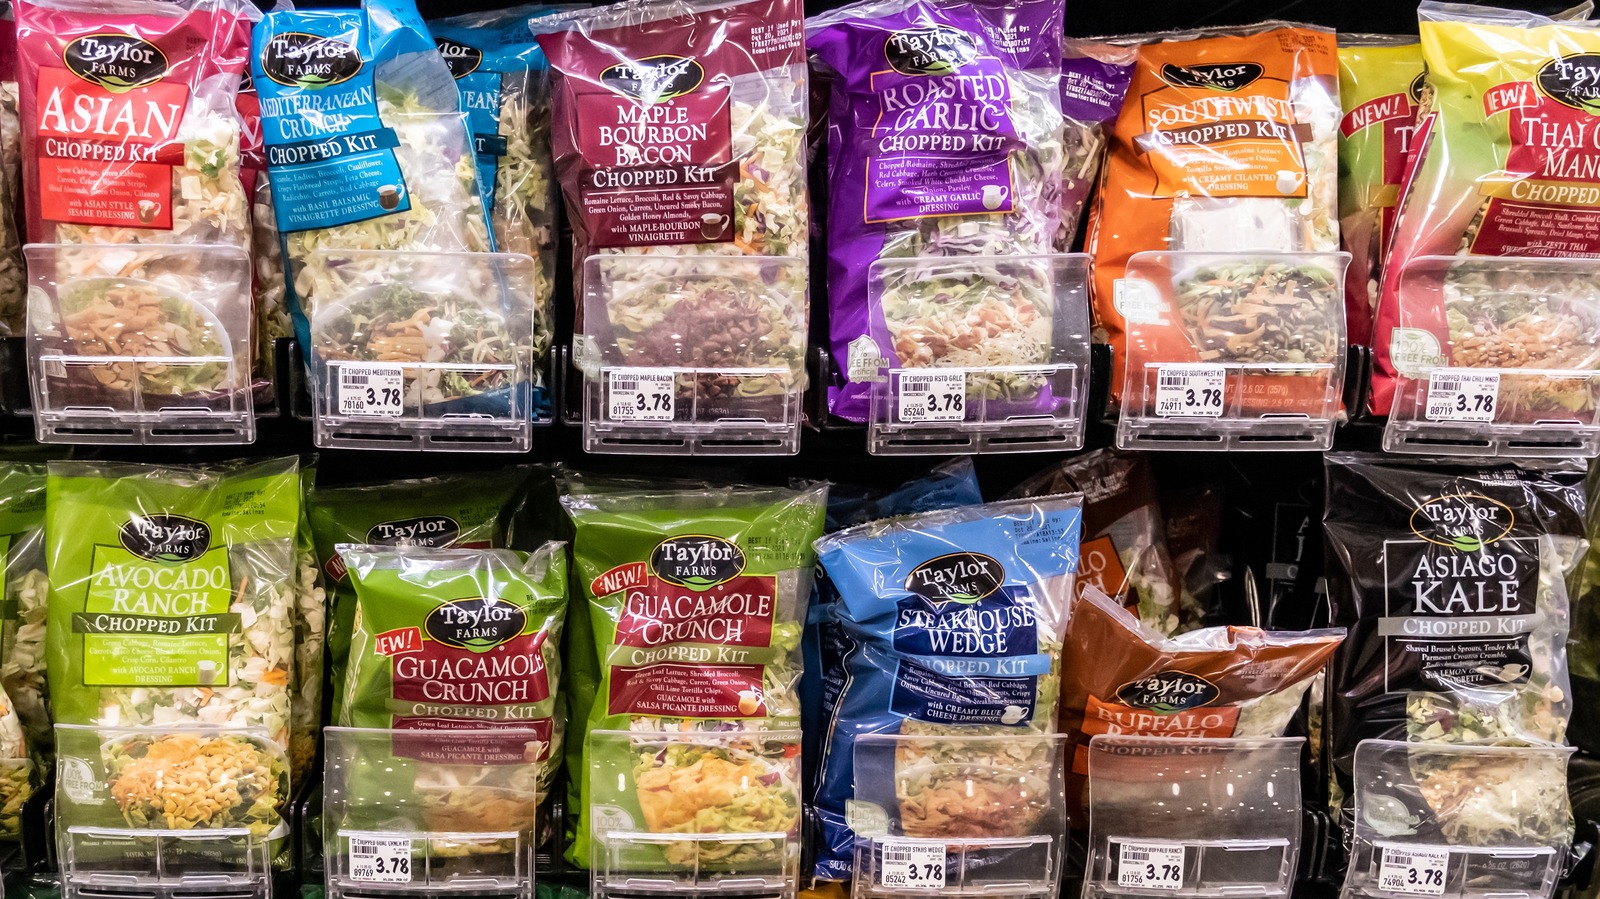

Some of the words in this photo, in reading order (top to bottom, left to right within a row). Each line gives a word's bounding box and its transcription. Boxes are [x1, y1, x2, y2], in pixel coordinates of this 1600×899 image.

[81, 38, 154, 64] Taylor
[890, 30, 962, 54] Taylor
[273, 40, 348, 64] Taylor
[92, 63, 136, 78] FARMS
[288, 64, 331, 75] FARMS
[883, 73, 1005, 112] ROASTED
[259, 86, 373, 118] MEDITERRANEAN
[1148, 95, 1291, 127] SOUTHWEST
[40, 86, 181, 139] ASIAN
[617, 105, 688, 124] MAPLE
[894, 104, 1000, 132] GARLIC
[1352, 96, 1399, 129] NEW!
[280, 112, 350, 139] CRUNCH
[599, 123, 707, 145] BOURBON
[1158, 122, 1250, 146] CHOPPED
[1255, 120, 1287, 138] KIT
[1520, 117, 1585, 148] THAI
[45, 139, 125, 161] CHOPPED
[129, 144, 161, 162] KIT
[270, 141, 342, 165] CHOPPED
[345, 135, 376, 154] KIT
[879, 134, 966, 154] CHOPPED
[972, 136, 1005, 151] KIT
[615, 145, 691, 166] BACON
[594, 167, 678, 187] CHOPPED
[685, 167, 716, 182] KIT
[1199, 174, 1232, 183] CREAMY
[1234, 173, 1276, 181] CILANTRO
[1208, 183, 1248, 191] DRESSING
[1511, 180, 1599, 204] CHOPPED
[84, 200, 107, 209] ASIAN
[109, 201, 133, 209] STYLE
[308, 200, 330, 211] BASIL
[332, 193, 370, 208] BALSAMIC
[589, 205, 606, 213] Green
[608, 205, 628, 213] Onion,
[630, 203, 652, 213] Carrots,
[654, 202, 679, 211] Uncured
[681, 202, 700, 210] Smoky
[702, 200, 722, 209] Bacon,
[896, 198, 912, 206] with
[914, 194, 948, 203] CREAMY
[950, 192, 980, 202] GARLIC
[919, 203, 959, 213] DRESSING
[68, 208, 94, 217] SESAME
[96, 209, 135, 220] DRESSING
[289, 208, 340, 223] VINAIGRETTE
[343, 202, 379, 217] DRESSING
[620, 213, 639, 221] Golden
[640, 212, 660, 222] Honey
[661, 211, 691, 220] Almonds,
[611, 225, 627, 233] with
[630, 221, 700, 231] MAPLE-BOURBON
[628, 232, 685, 241] VINAIGRETTE
[344, 401, 364, 409] 78160
[366, 388, 400, 406] 3.78
[637, 393, 671, 411] 3.78
[927, 394, 962, 412] 3.78
[1161, 402, 1182, 410] 74911
[1186, 389, 1222, 407] 3.78
[1456, 394, 1494, 412] 3.78
[613, 406, 634, 415] 81755
[904, 408, 925, 416] 85240
[1426, 503, 1499, 525] Taylor
[139, 520, 203, 541] Taylor
[378, 519, 446, 541] Taylor
[149, 542, 190, 554] FARMS
[662, 543, 732, 563] Taylor
[676, 566, 717, 576] FARMS
[916, 560, 989, 588] Taylor
[1413, 554, 1517, 579] ASIAGO
[95, 561, 227, 591] AVOCADO
[603, 567, 642, 593] NEW!
[111, 588, 209, 615] RANCH
[627, 591, 771, 619] GUACAMOLE
[1411, 581, 1521, 614] KALE
[95, 615, 181, 634] CHOPPED
[186, 617, 217, 632] KIT
[440, 605, 513, 629] Taylor
[899, 604, 1035, 631] STEAKHOUSE
[456, 627, 498, 639] FARMS
[642, 618, 742, 644] CRUNCH
[1403, 618, 1491, 635] CHOPPED
[1496, 618, 1527, 633] KIT
[929, 630, 1008, 654] WEDGE
[631, 647, 711, 666] CHOPPED
[717, 647, 749, 663] KIT
[129, 666, 167, 674] AVOCADO
[396, 654, 544, 680] GUACAMOLE
[996, 658, 1028, 674] KIT
[135, 675, 173, 683] DRESSING
[1135, 675, 1207, 696] Taylor
[423, 680, 528, 702] CRUNCH
[657, 694, 700, 703] GUACAMOLE
[1142, 694, 1187, 705] FARMS
[412, 703, 498, 719] CHOPPED
[503, 705, 537, 719] KIT
[637, 701, 660, 709] SALSA
[662, 702, 697, 711] PICANTE
[699, 704, 737, 712] DRESSING
[927, 701, 944, 710] with
[945, 703, 979, 715] CREAMY
[981, 708, 1001, 716] BLUE
[927, 709, 957, 720] CHEESE
[1097, 706, 1223, 731] BUFFALO
[354, 868, 373, 876] 89769
[376, 857, 409, 874] 3.78
[909, 863, 943, 881] 3.78
[1146, 864, 1180, 881] 3.78
[885, 875, 906, 883] 85242
[1122, 874, 1143, 883] 81756
[1384, 878, 1404, 887] 74904
[1408, 868, 1442, 886] 3.78
